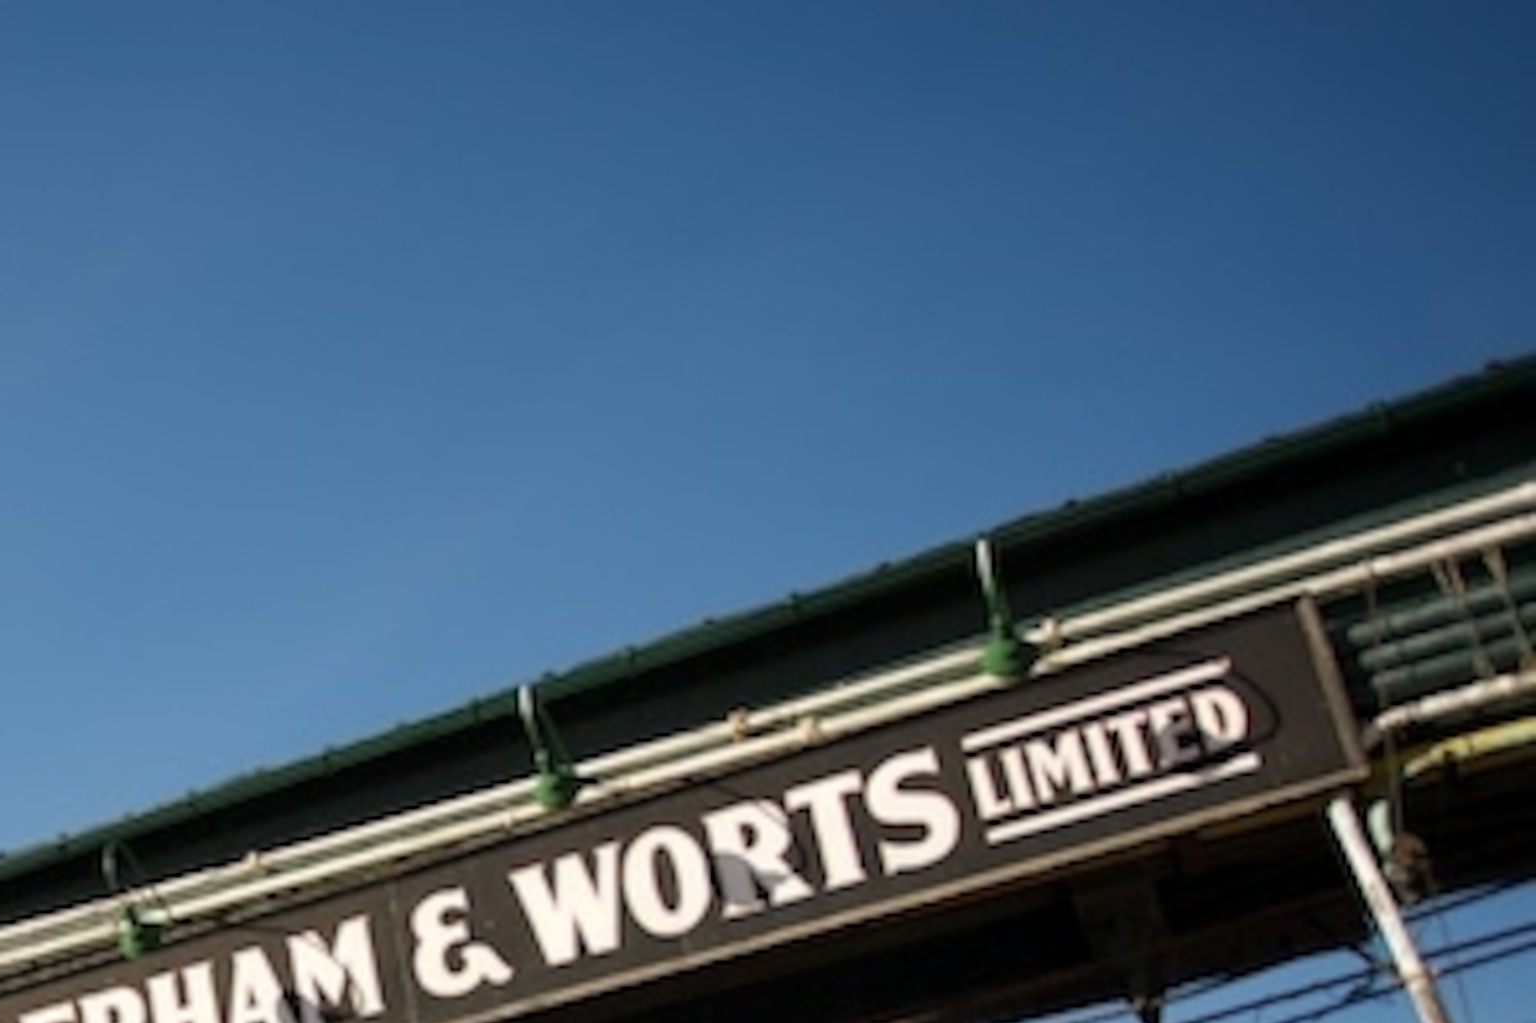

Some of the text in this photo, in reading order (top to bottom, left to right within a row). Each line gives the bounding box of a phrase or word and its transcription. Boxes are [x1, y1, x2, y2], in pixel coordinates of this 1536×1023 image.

[410, 886, 513, 998] &
[508, 747, 963, 967] WORTS
[965, 684, 1250, 821] LIMITED
